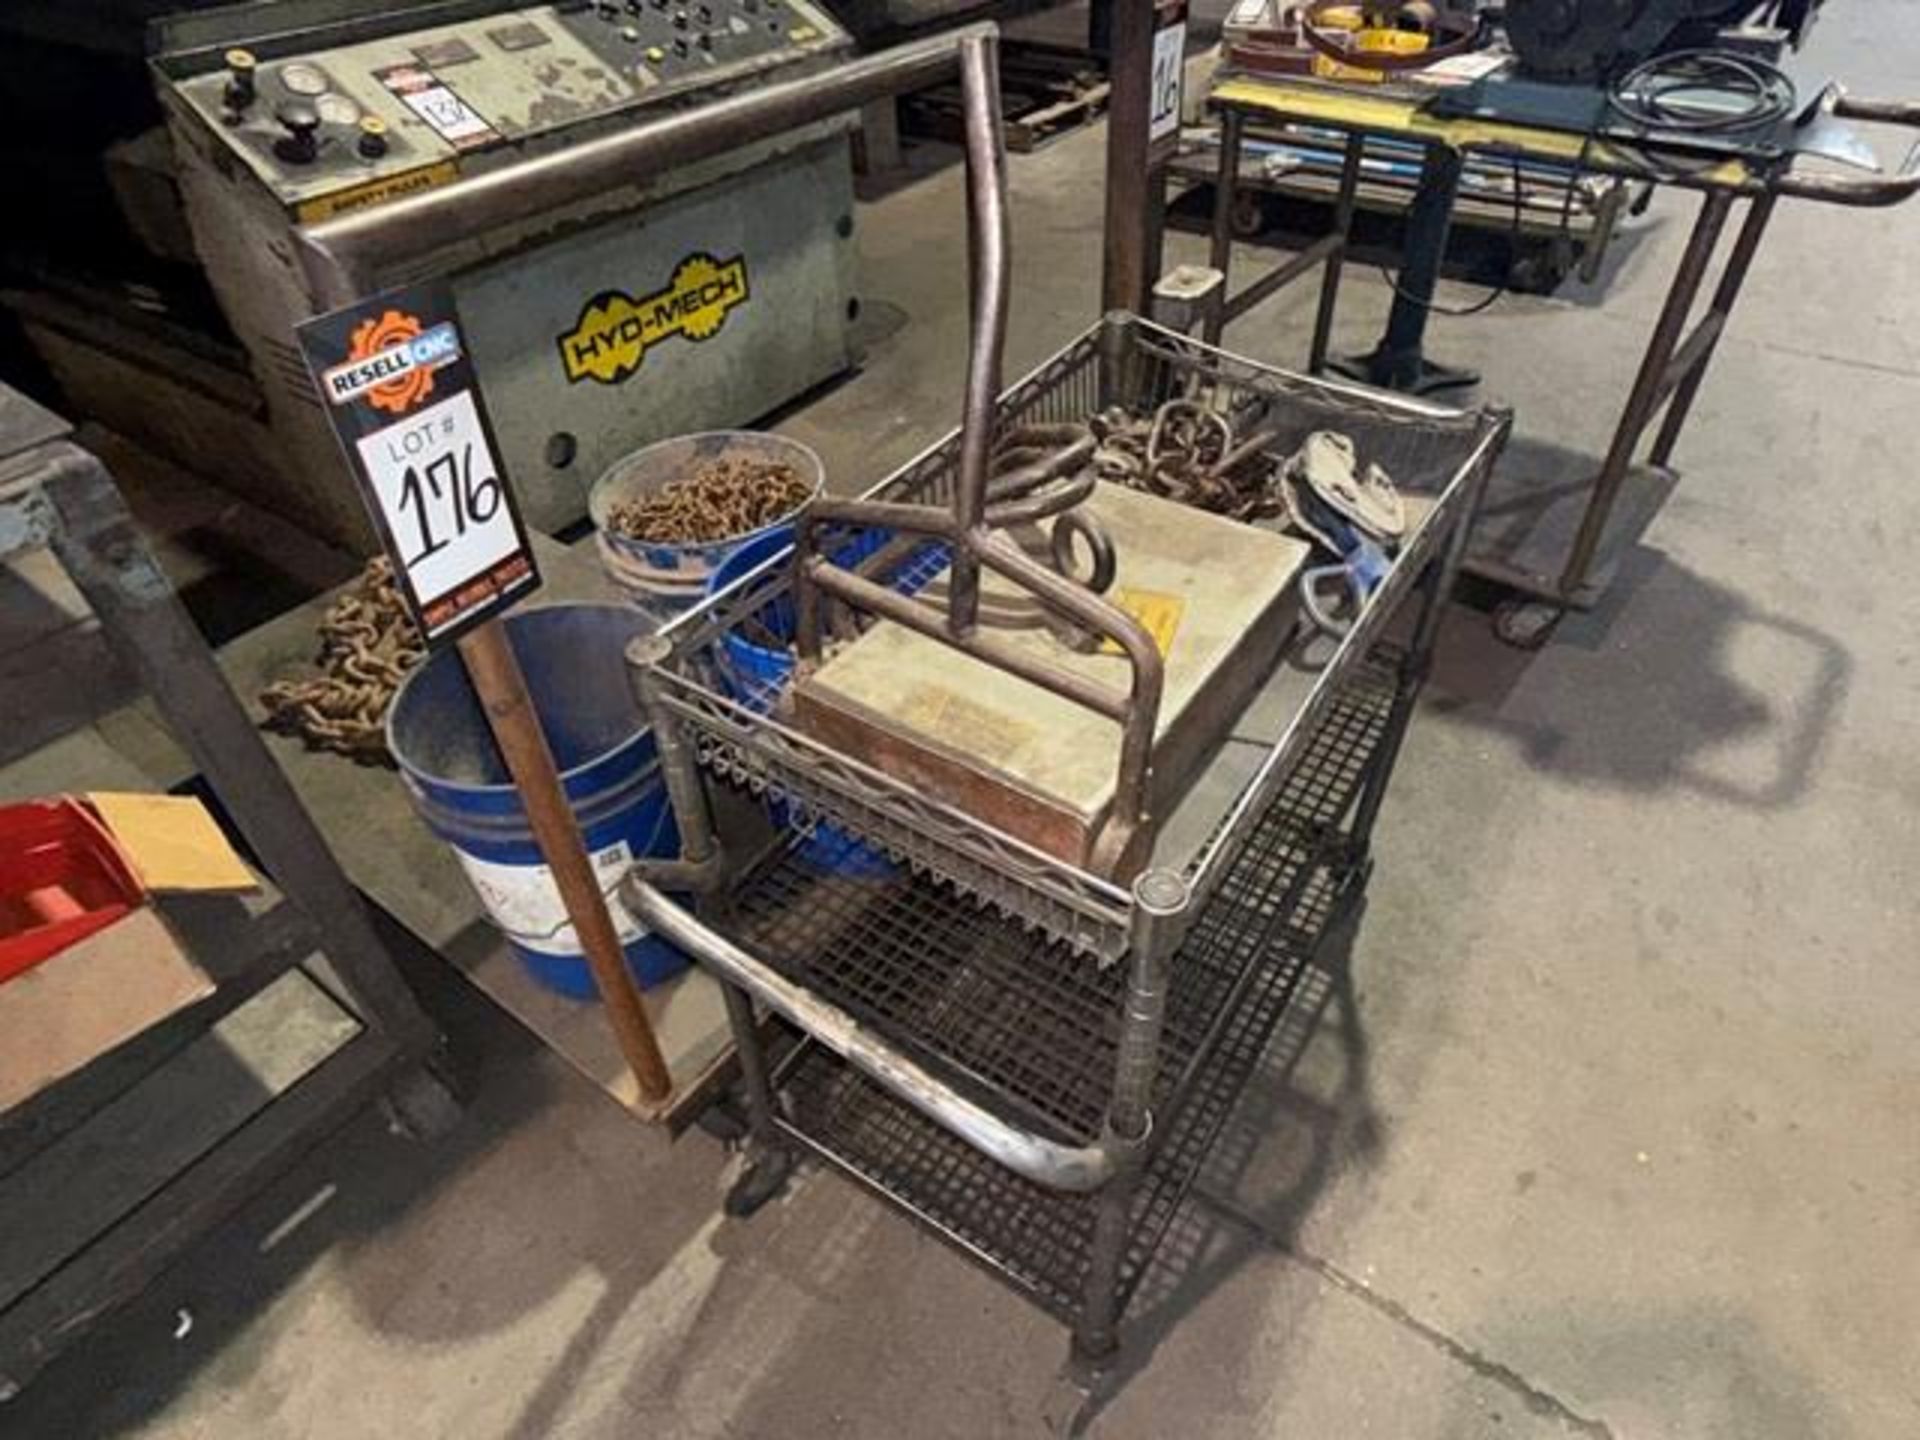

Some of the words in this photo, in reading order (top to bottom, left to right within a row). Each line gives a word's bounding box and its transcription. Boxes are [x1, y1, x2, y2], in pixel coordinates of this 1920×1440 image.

[573, 270, 739, 366] HYD-MECH
[332, 353, 410, 395] RESELL
[387, 423, 434, 464] LOT
[442, 416, 456, 435] #
[398, 443, 501, 570] 176
